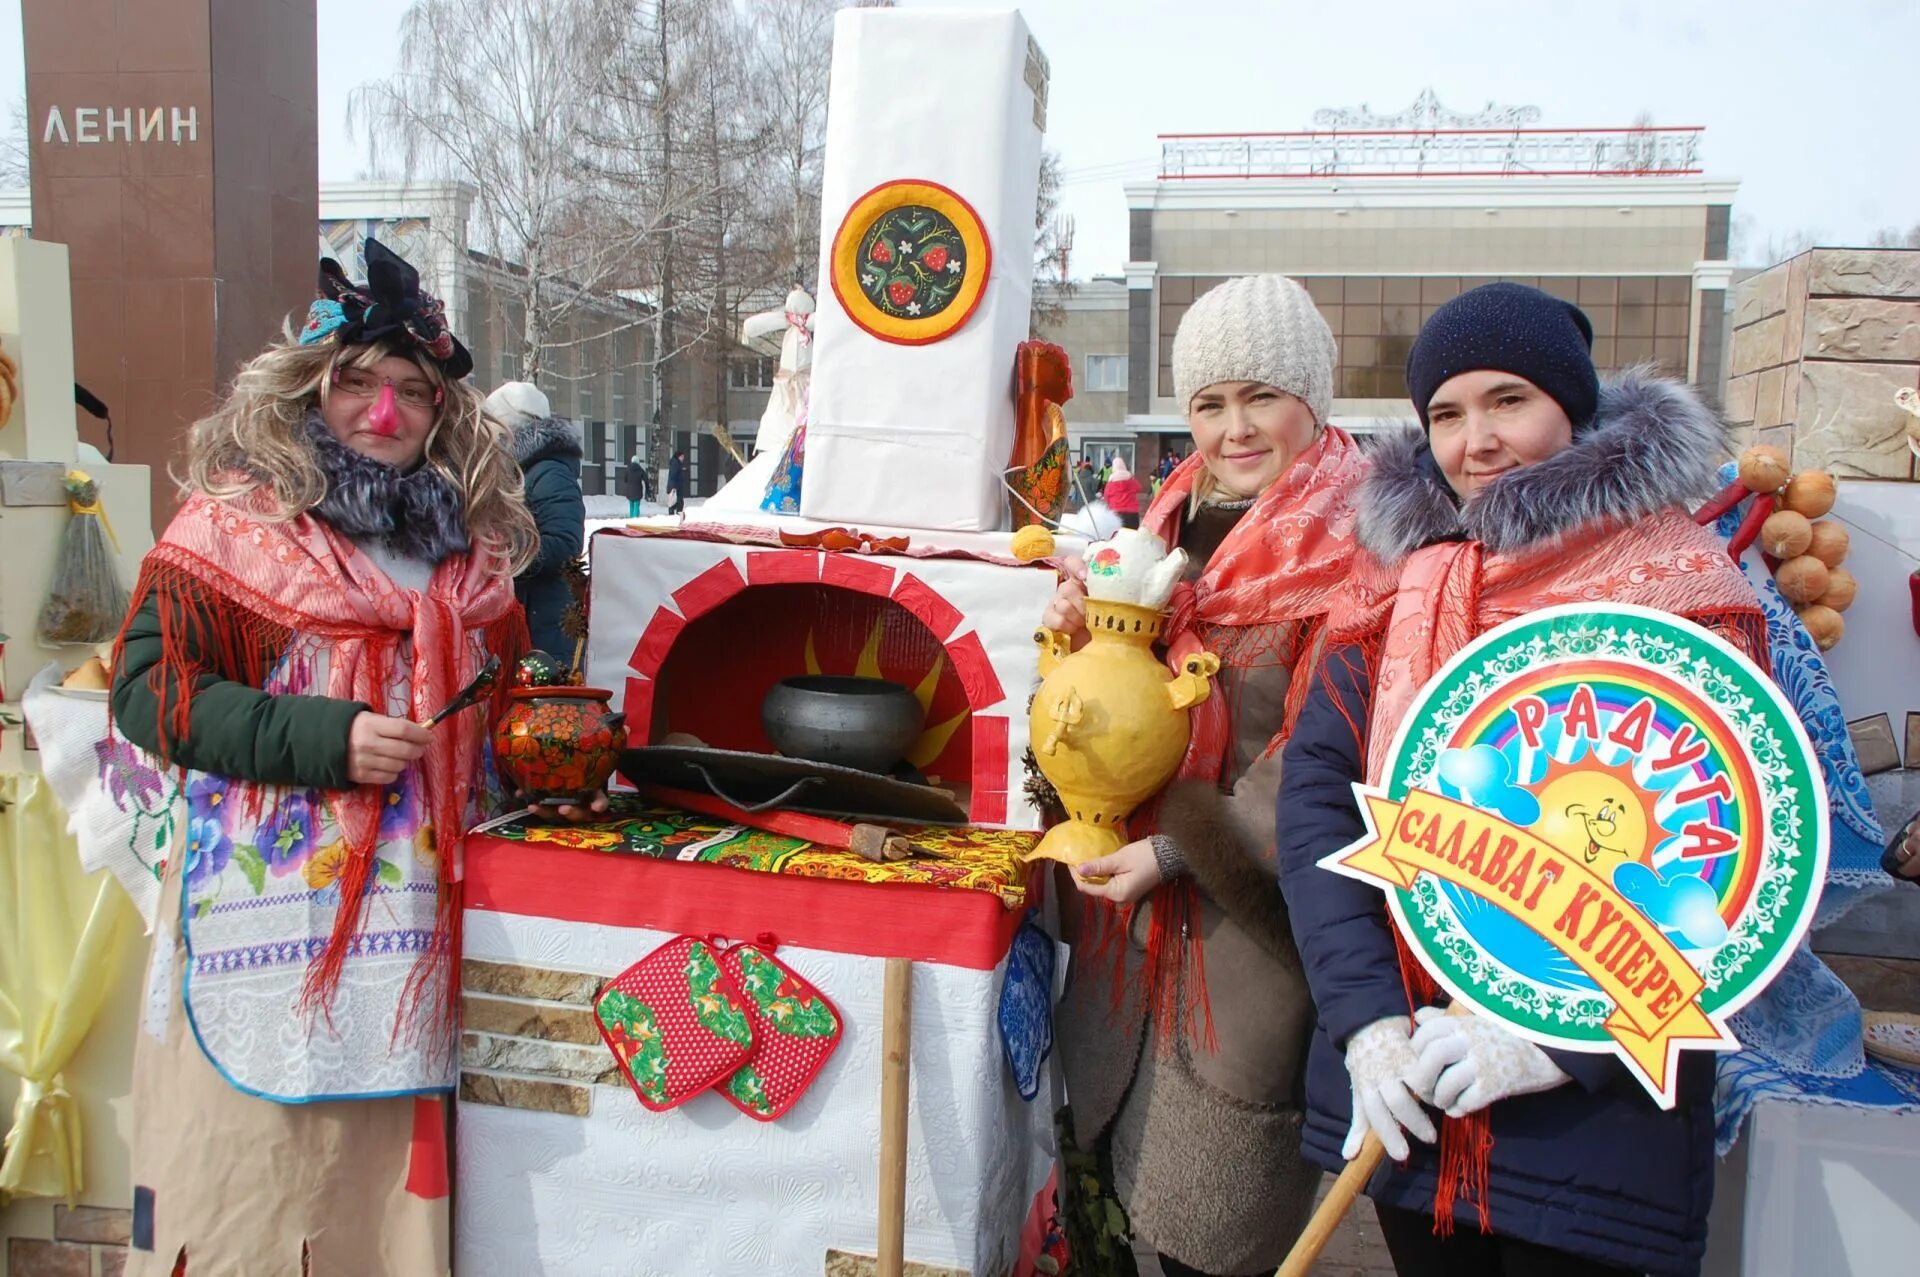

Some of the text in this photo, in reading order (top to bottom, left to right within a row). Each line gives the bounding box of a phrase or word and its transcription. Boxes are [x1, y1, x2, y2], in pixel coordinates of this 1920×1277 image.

[43, 105, 198, 143] ЛЕНИН
[1511, 687, 1738, 858] РАДУГА
[1400, 809, 1565, 911] САЛАВАТ
